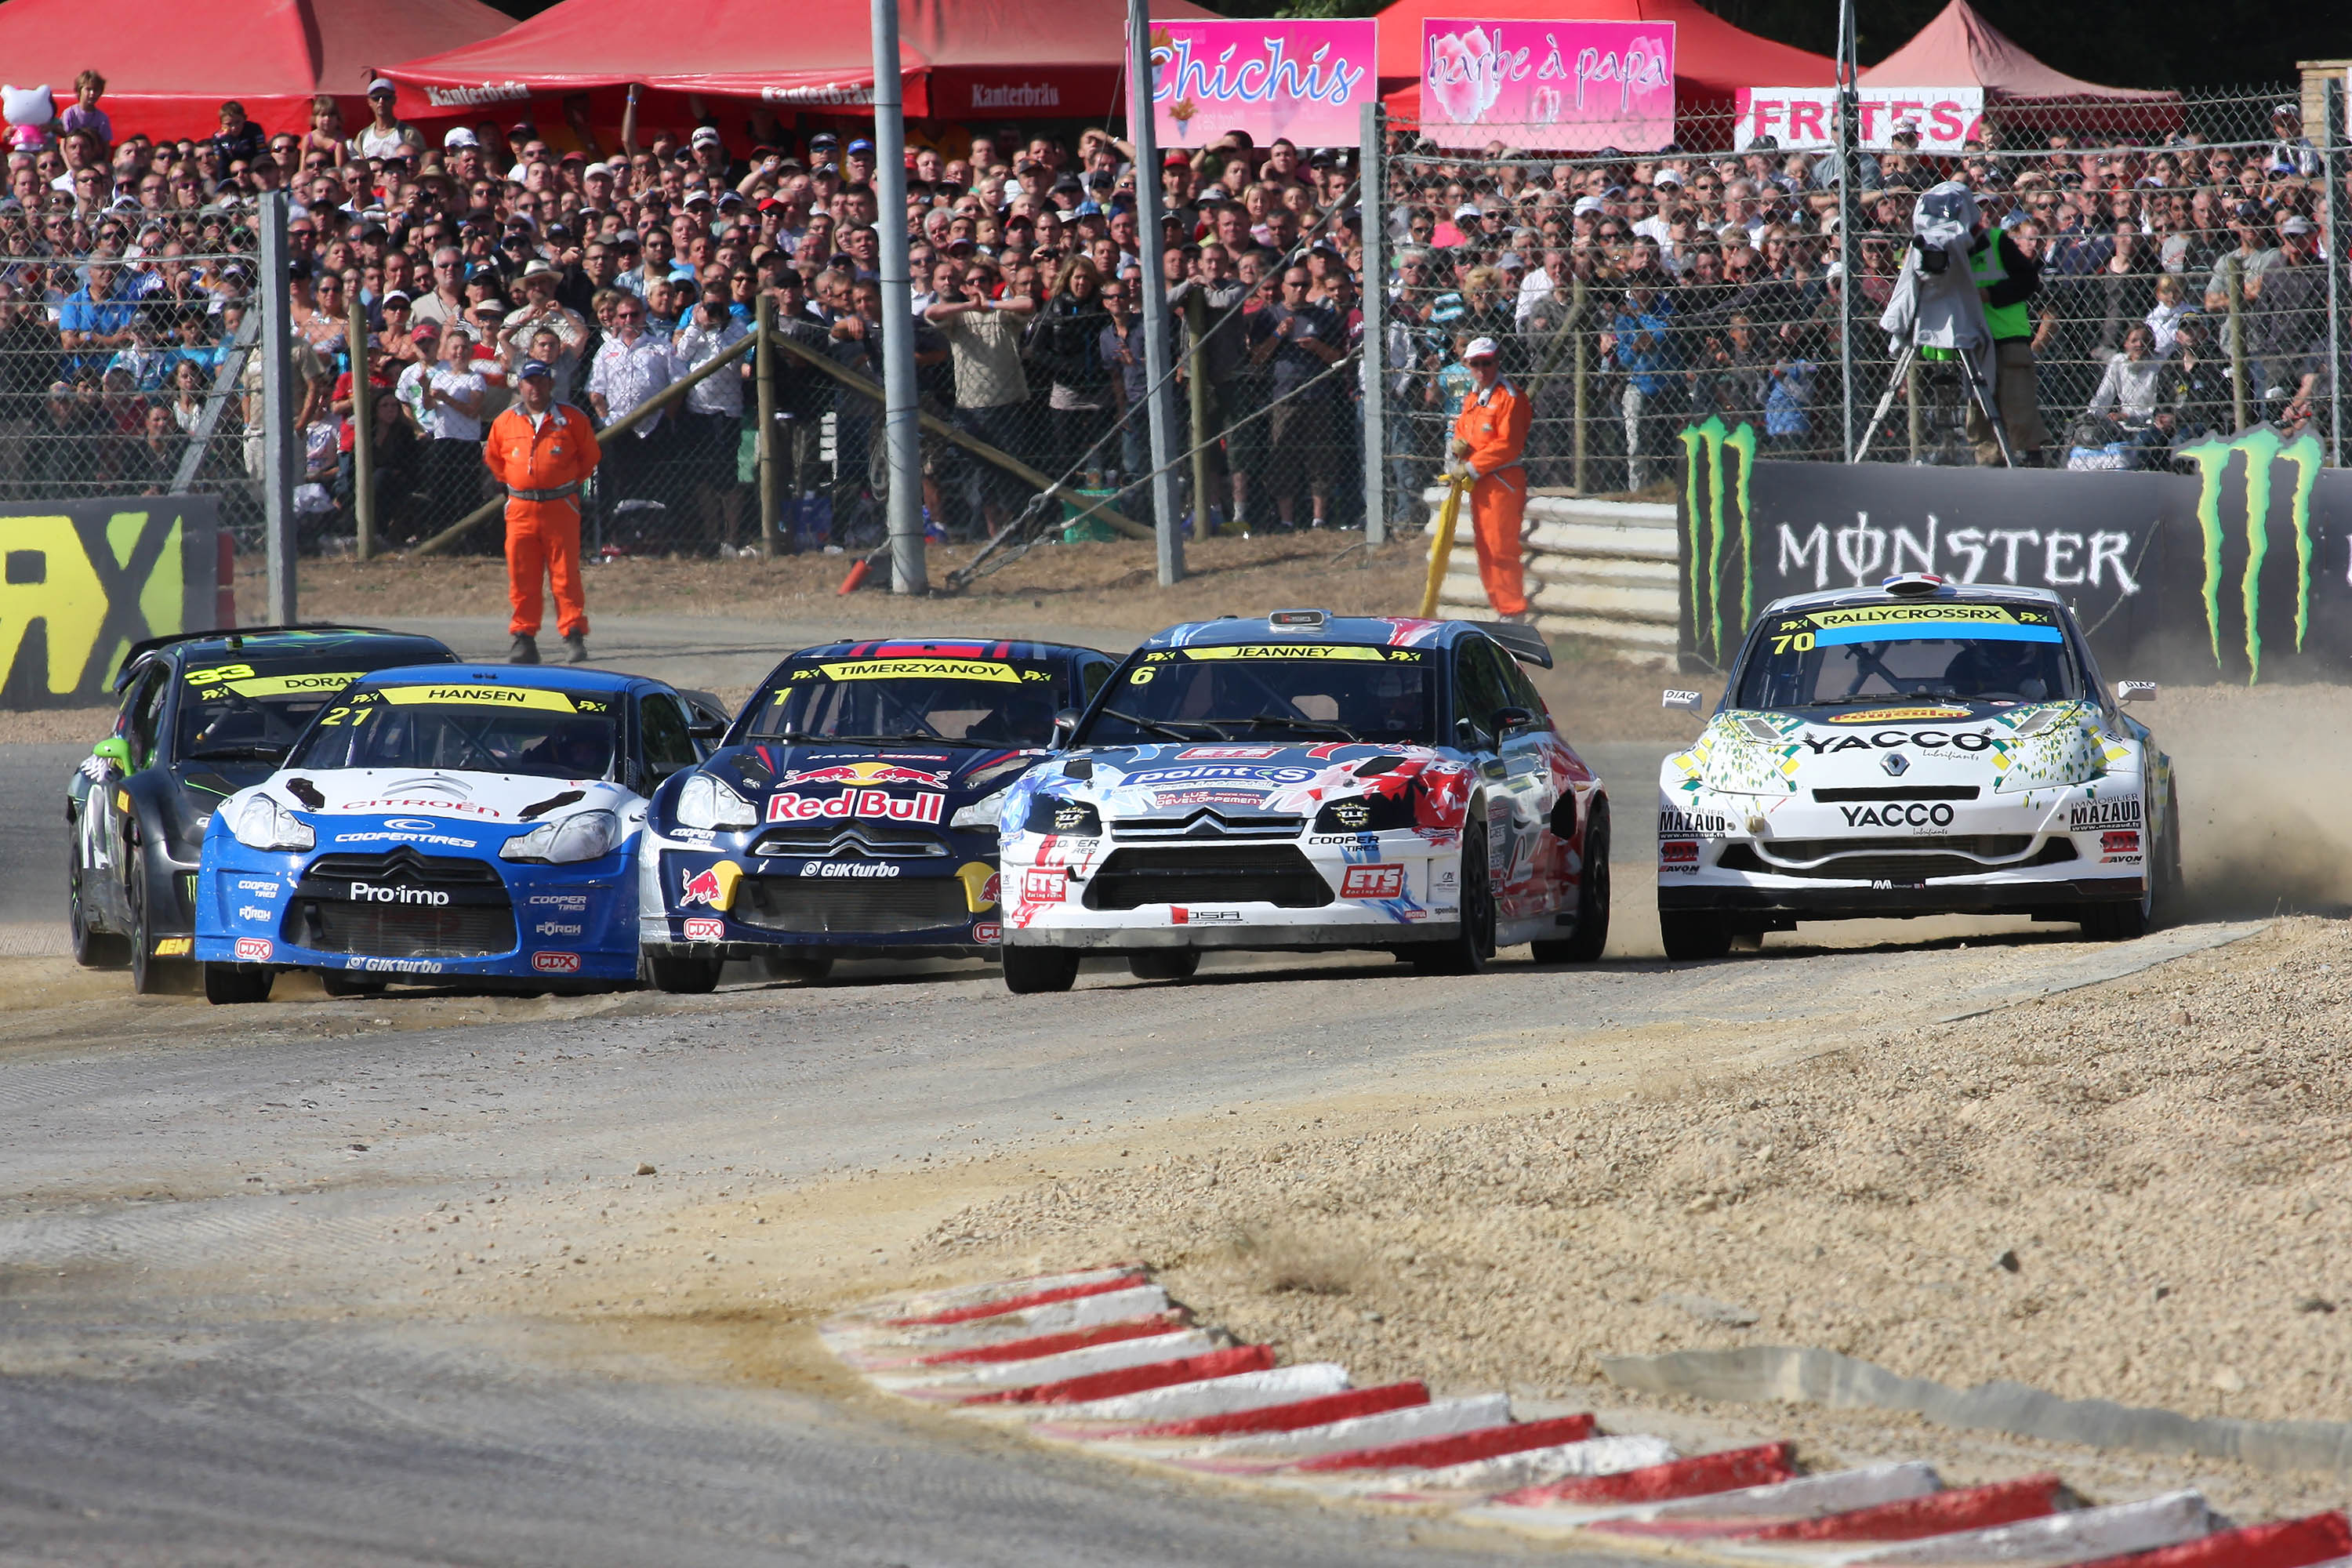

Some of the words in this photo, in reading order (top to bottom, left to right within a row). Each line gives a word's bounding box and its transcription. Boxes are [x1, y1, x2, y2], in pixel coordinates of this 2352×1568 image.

[1574, 47, 1668, 112] papa
[424, 80, 532, 107] Kanterbräu
[971, 82, 1059, 107] Kanterbräu
[1754, 100, 1964, 141] FRTES
[1777, 511, 2140, 596] MONSTER
[1823, 608, 2002, 626] RALLYCROSSRX
[1230, 646, 1336, 659] JEANNEY
[1770, 632, 1815, 655] 70
[184, 664, 256, 685] 33
[837, 663, 1007, 677] TIMERZYANOV
[1129, 666, 1156, 685] 6
[427, 688, 527, 702] HANSEN
[773, 687, 793, 706] 1
[1664, 691, 1696, 701] DIAC
[320, 707, 373, 727] 21
[1801, 731, 1992, 755] YACCO
[342, 799, 501, 818] CITROËN
[769, 791, 855, 821] Red
[858, 791, 943, 822] Bull
[1661, 804, 1725, 816] IMMOBILIER
[2071, 793, 2139, 808] IMMOBILIER
[1660, 811, 1726, 831] MAZAUD
[1838, 803, 1955, 827] YACCO
[2071, 800, 2141, 825] MAZAUD
[669, 828, 717, 840] COOPER
[1308, 835, 1380, 845] COOPER
[1039, 839, 1101, 849] COOER
[821, 861, 901, 877] GIKturbo
[1348, 869, 1401, 888] ETS
[238, 880, 280, 891] COOPER
[1027, 872, 1065, 892] ETS
[529, 895, 587, 905] COOPER
[687, 922, 720, 936] CDX
[238, 942, 268, 956] CDX
[365, 957, 442, 975] GIKturbo
[536, 955, 576, 969] CDX
